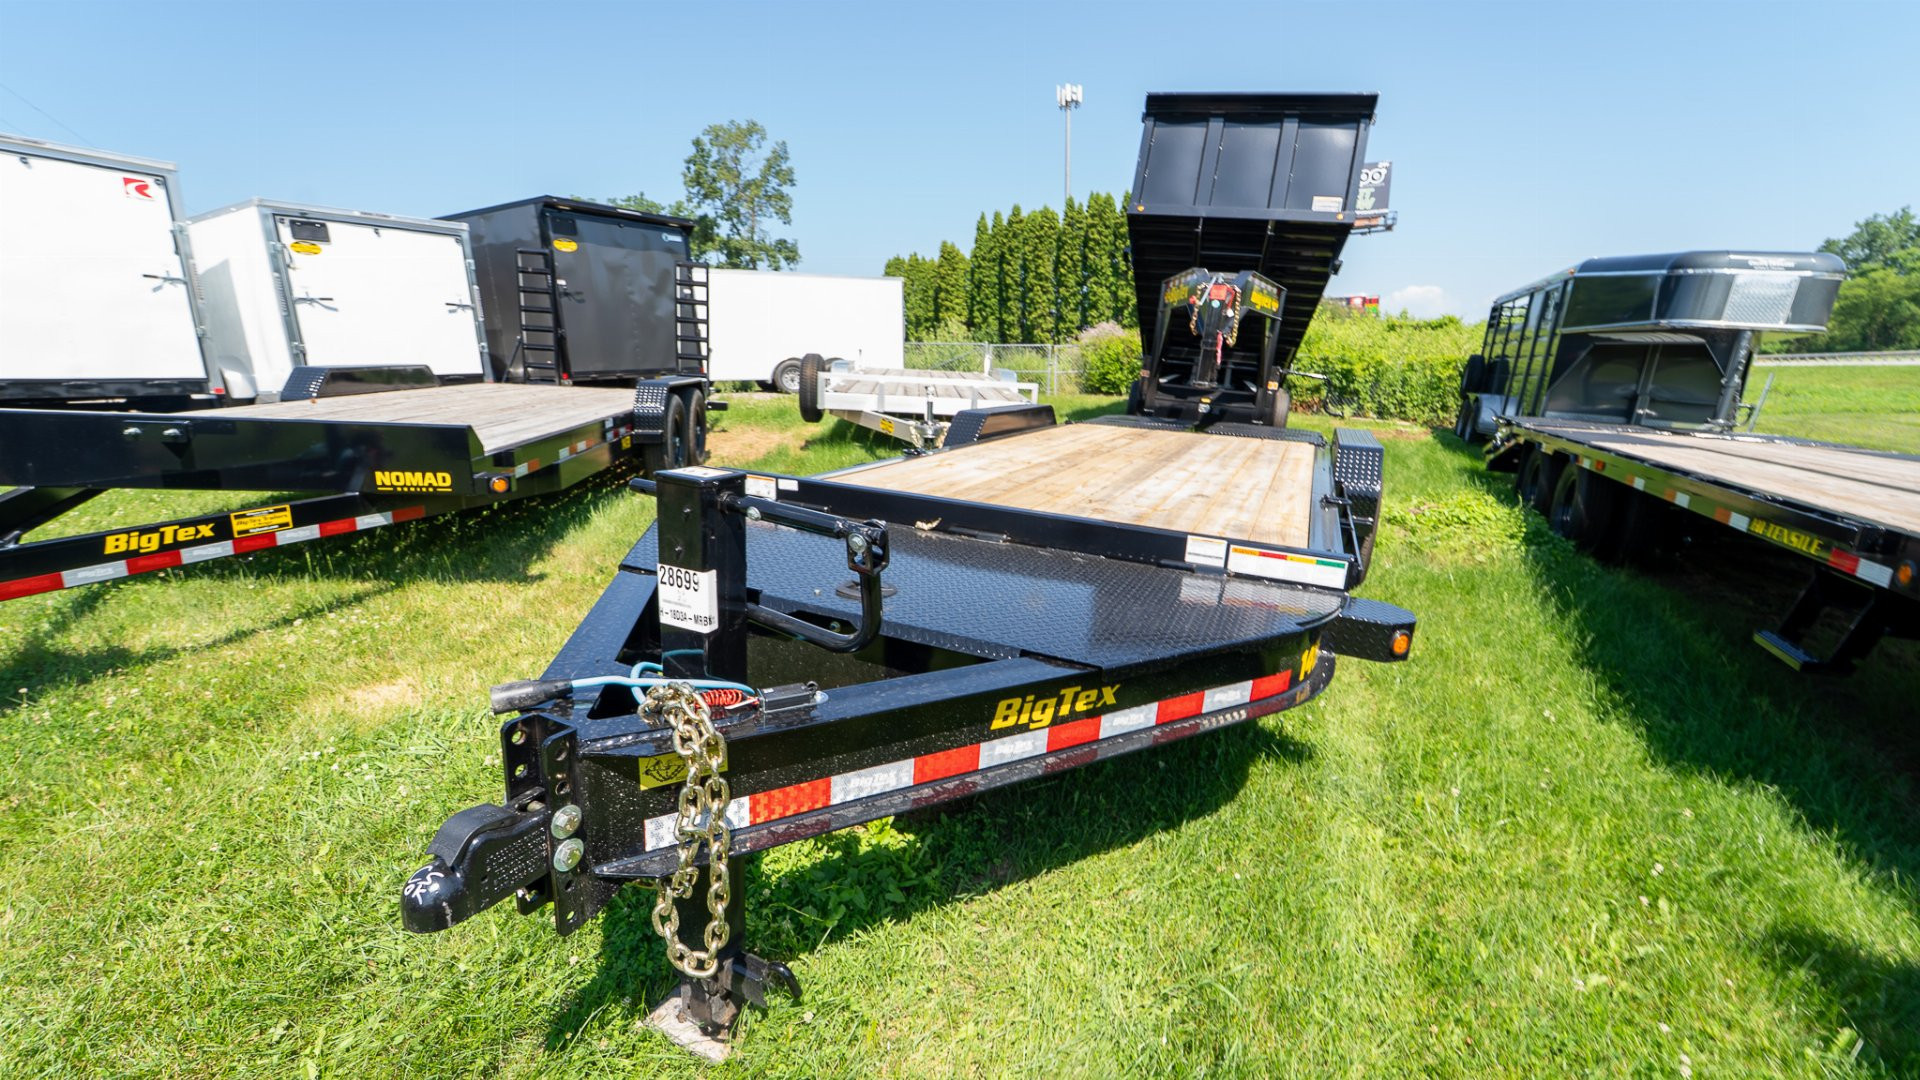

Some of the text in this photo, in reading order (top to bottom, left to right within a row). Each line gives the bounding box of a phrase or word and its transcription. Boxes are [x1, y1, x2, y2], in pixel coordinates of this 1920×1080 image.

[375, 471, 452, 487] NOMAD
[104, 523, 215, 553] BigTex
[659, 565, 700, 592] 28699
[990, 683, 1121, 730] BigTex
